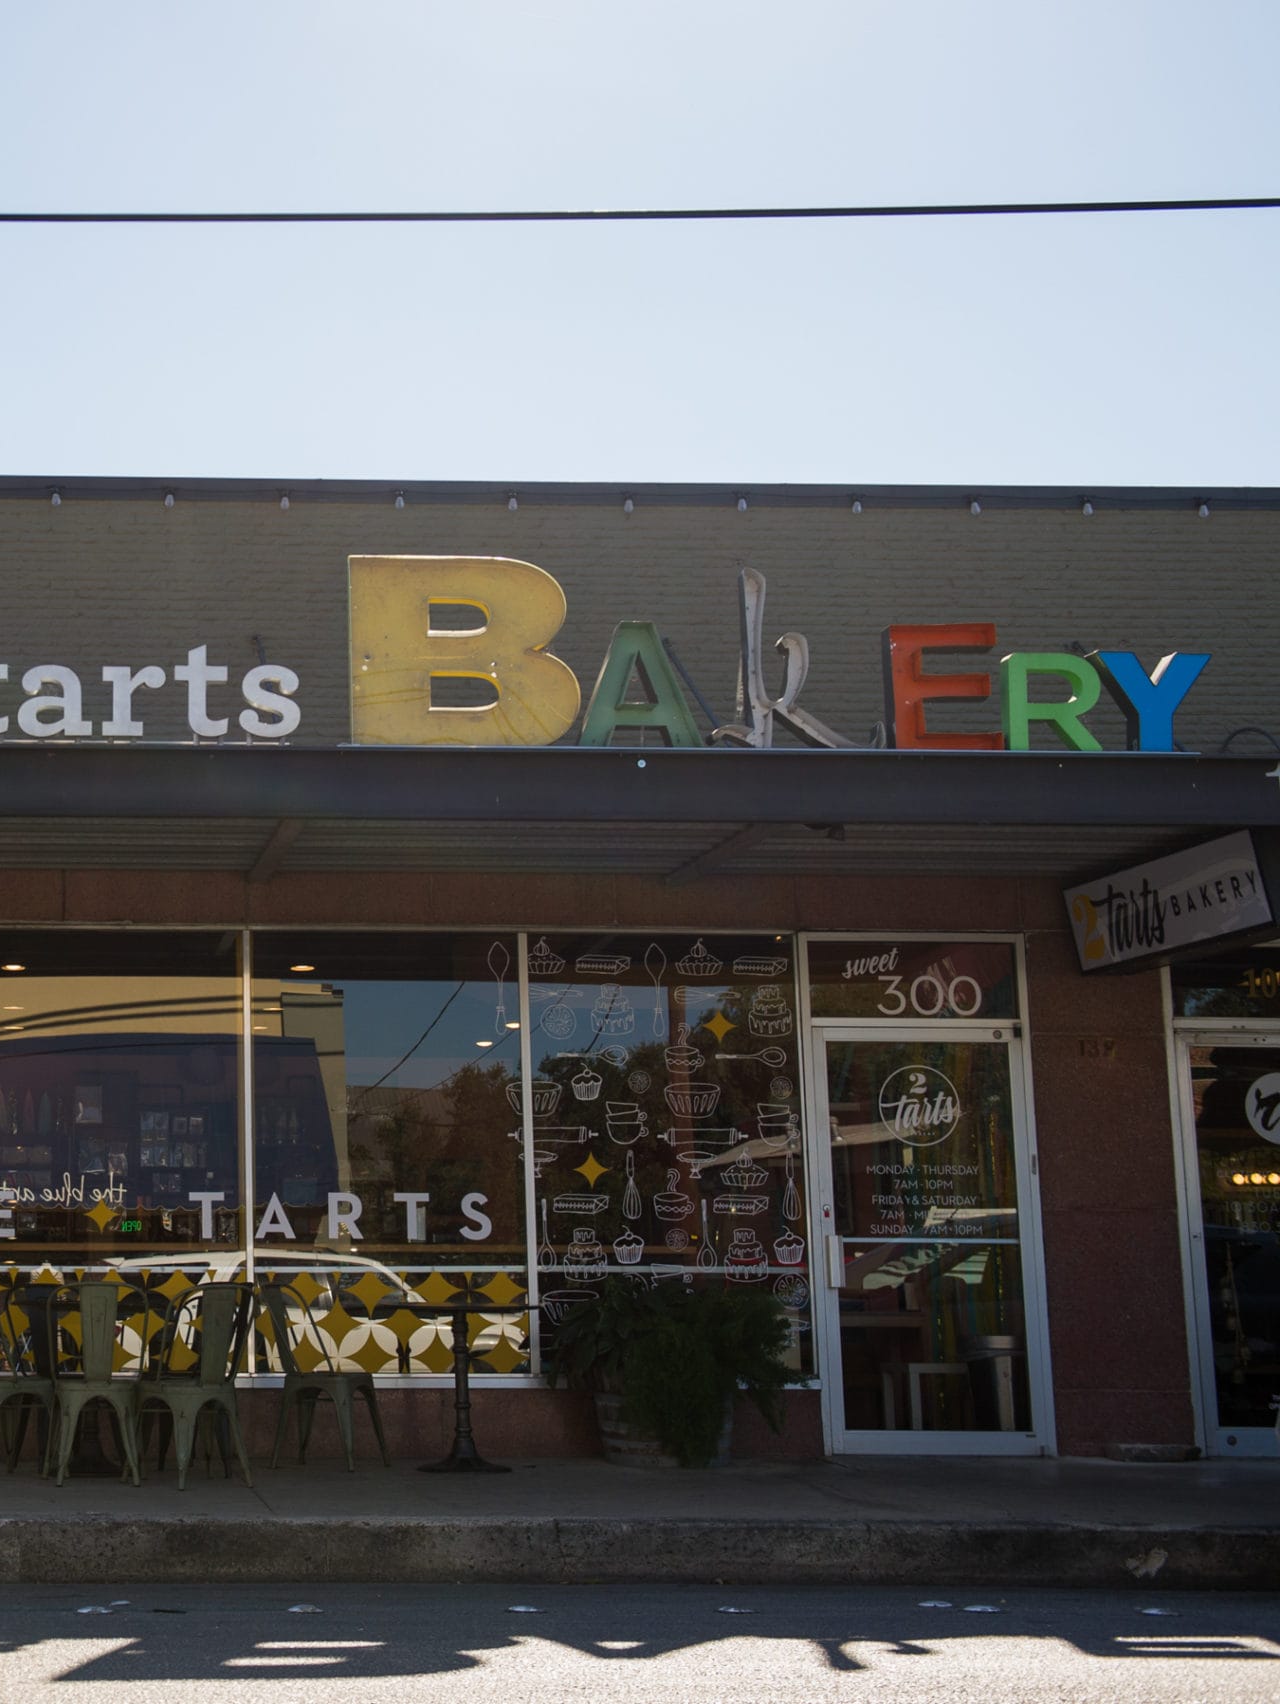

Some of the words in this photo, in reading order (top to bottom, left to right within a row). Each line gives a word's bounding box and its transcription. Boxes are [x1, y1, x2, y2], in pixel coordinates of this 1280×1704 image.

[1170, 871, 1256, 915] BAKERY
[842, 946, 900, 980] sweet
[877, 975, 982, 1016] 300
[908, 1072, 927, 1094] 2
[880, 1091, 954, 1131] tarts
[866, 1165, 914, 1175] MONDAY
[922, 1165, 979, 1175] THURSDAY
[894, 1180, 918, 1190] 7AM
[922, 1195, 977, 1205] SATURDAY
[188, 1192, 493, 1240] TARTS
[880, 1210, 904, 1220] 7AM
[870, 1224, 914, 1234] SUNDAY
[955, 1225, 982, 1234] 10PM
